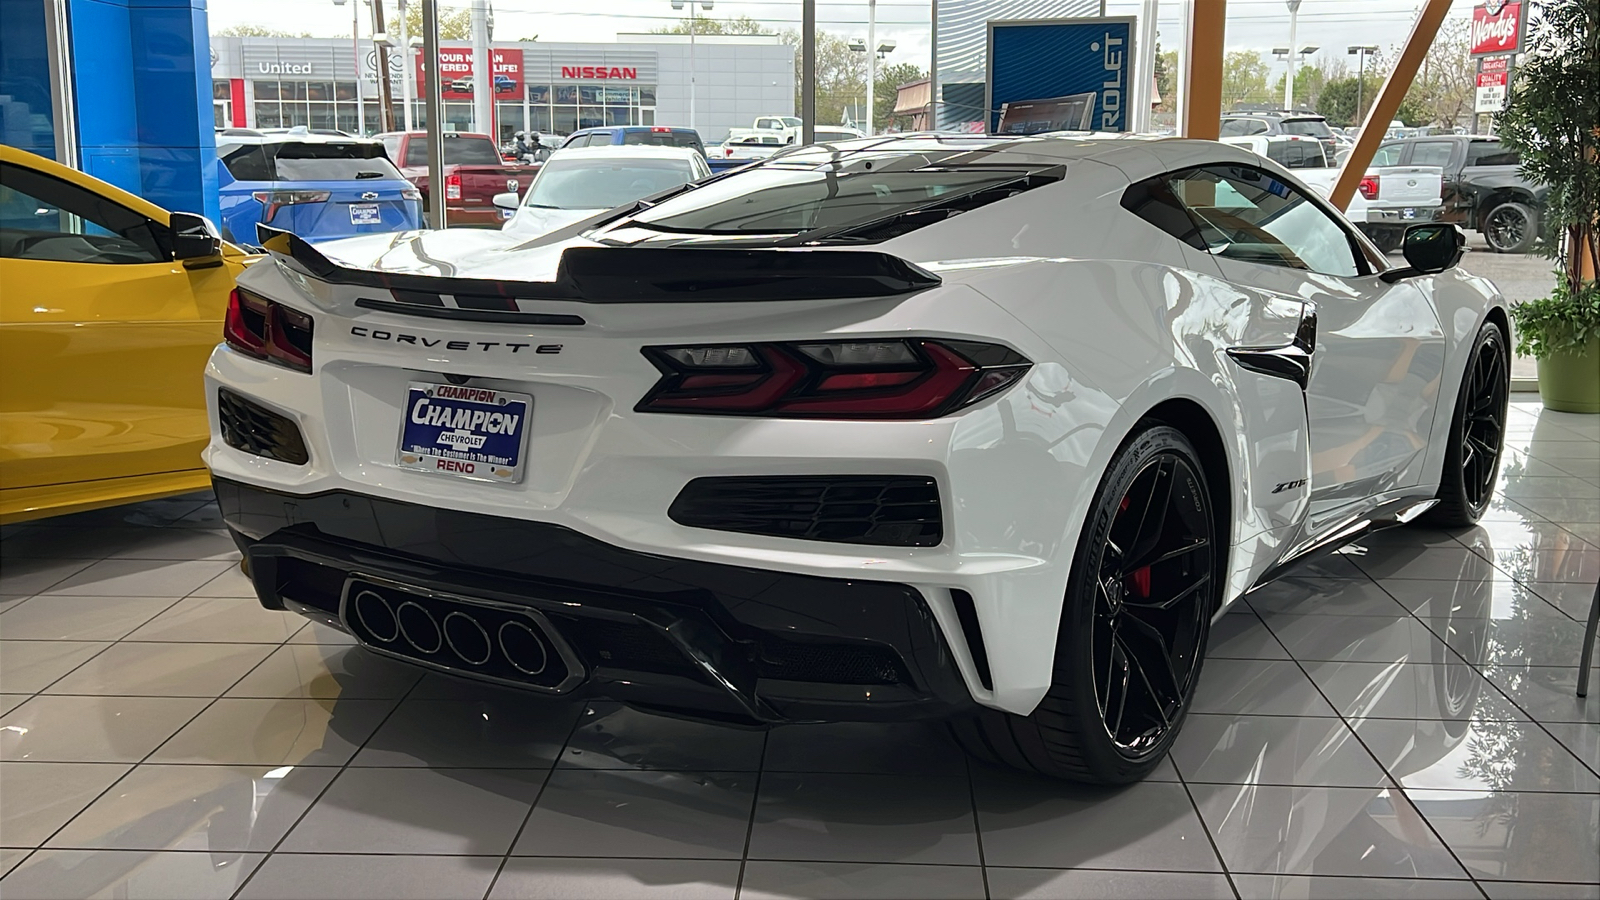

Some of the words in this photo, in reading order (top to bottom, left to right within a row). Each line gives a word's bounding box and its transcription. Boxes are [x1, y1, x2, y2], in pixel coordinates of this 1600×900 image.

[1472, 9, 1516, 50] Wendy's
[259, 61, 312, 74] United
[421, 63, 469, 72] CERED
[494, 64, 518, 73] LIFE!
[561, 66, 637, 79] NISSAN
[1481, 73, 1502, 82] QUALITY
[350, 326, 563, 354] CORVETTE
[436, 386, 497, 403] CHAMPION
[411, 398, 519, 436] CHAMPION
[440, 433, 483, 446] CHEVROLET
[432, 448, 442, 457] The
[442, 448, 469, 460] Customer
[469, 452, 476, 461] Is
[477, 453, 487, 462] The
[436, 459, 475, 474] RENO
